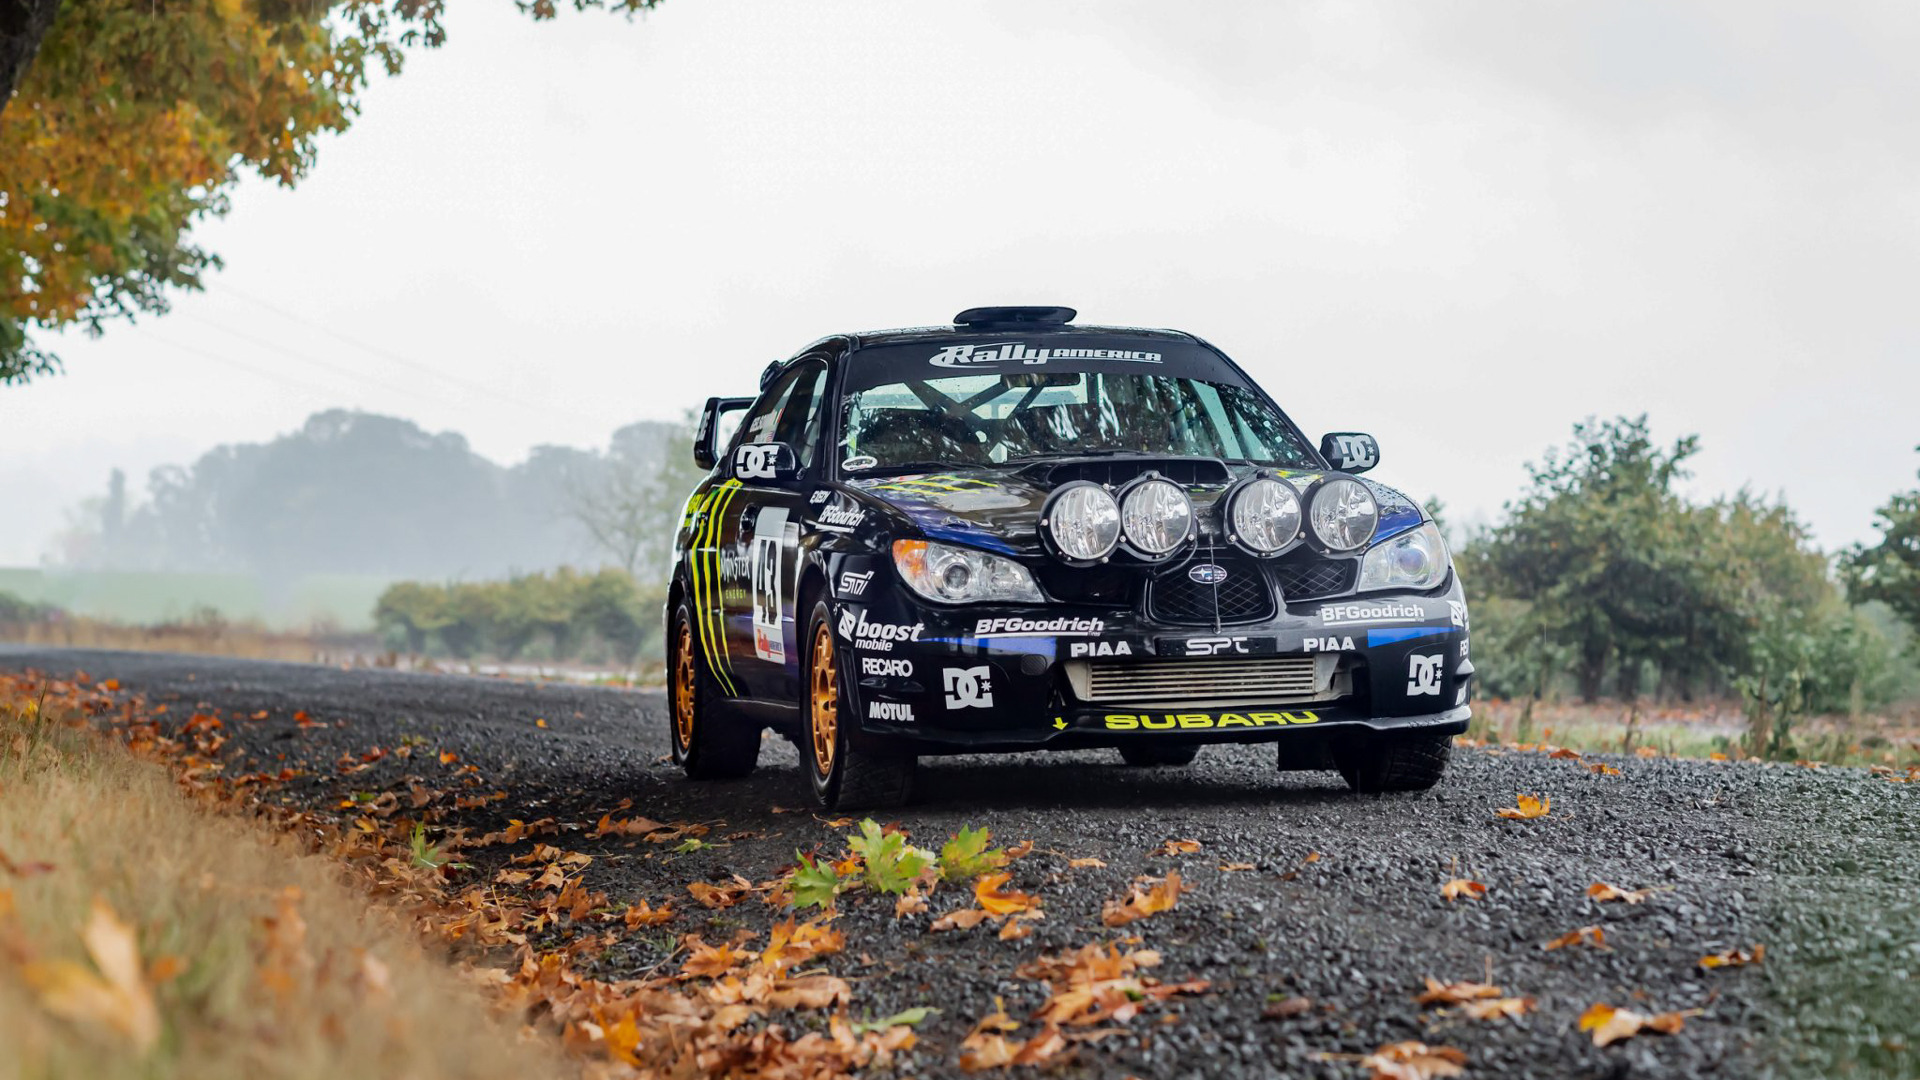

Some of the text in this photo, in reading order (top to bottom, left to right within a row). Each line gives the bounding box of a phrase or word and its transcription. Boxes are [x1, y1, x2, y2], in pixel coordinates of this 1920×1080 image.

[929, 344, 1162, 366] Rally AMERICA
[736, 445, 780, 478] DC
[1335, 435, 1375, 469] DC
[818, 505, 866, 527] BFGoodrich
[1321, 604, 1425, 621] BFGoodrich
[855, 609, 925, 642] boost
[975, 617, 1104, 634] BFGoodrich
[855, 639, 894, 651] mobile
[1070, 640, 1133, 658] PIAA
[1303, 636, 1356, 652] PIAA
[862, 657, 914, 677] RECARO
[1406, 654, 1444, 697] DC
[943, 665, 994, 710] DC
[869, 701, 915, 721] MOTUL
[1104, 711, 1320, 730] SUBARU
